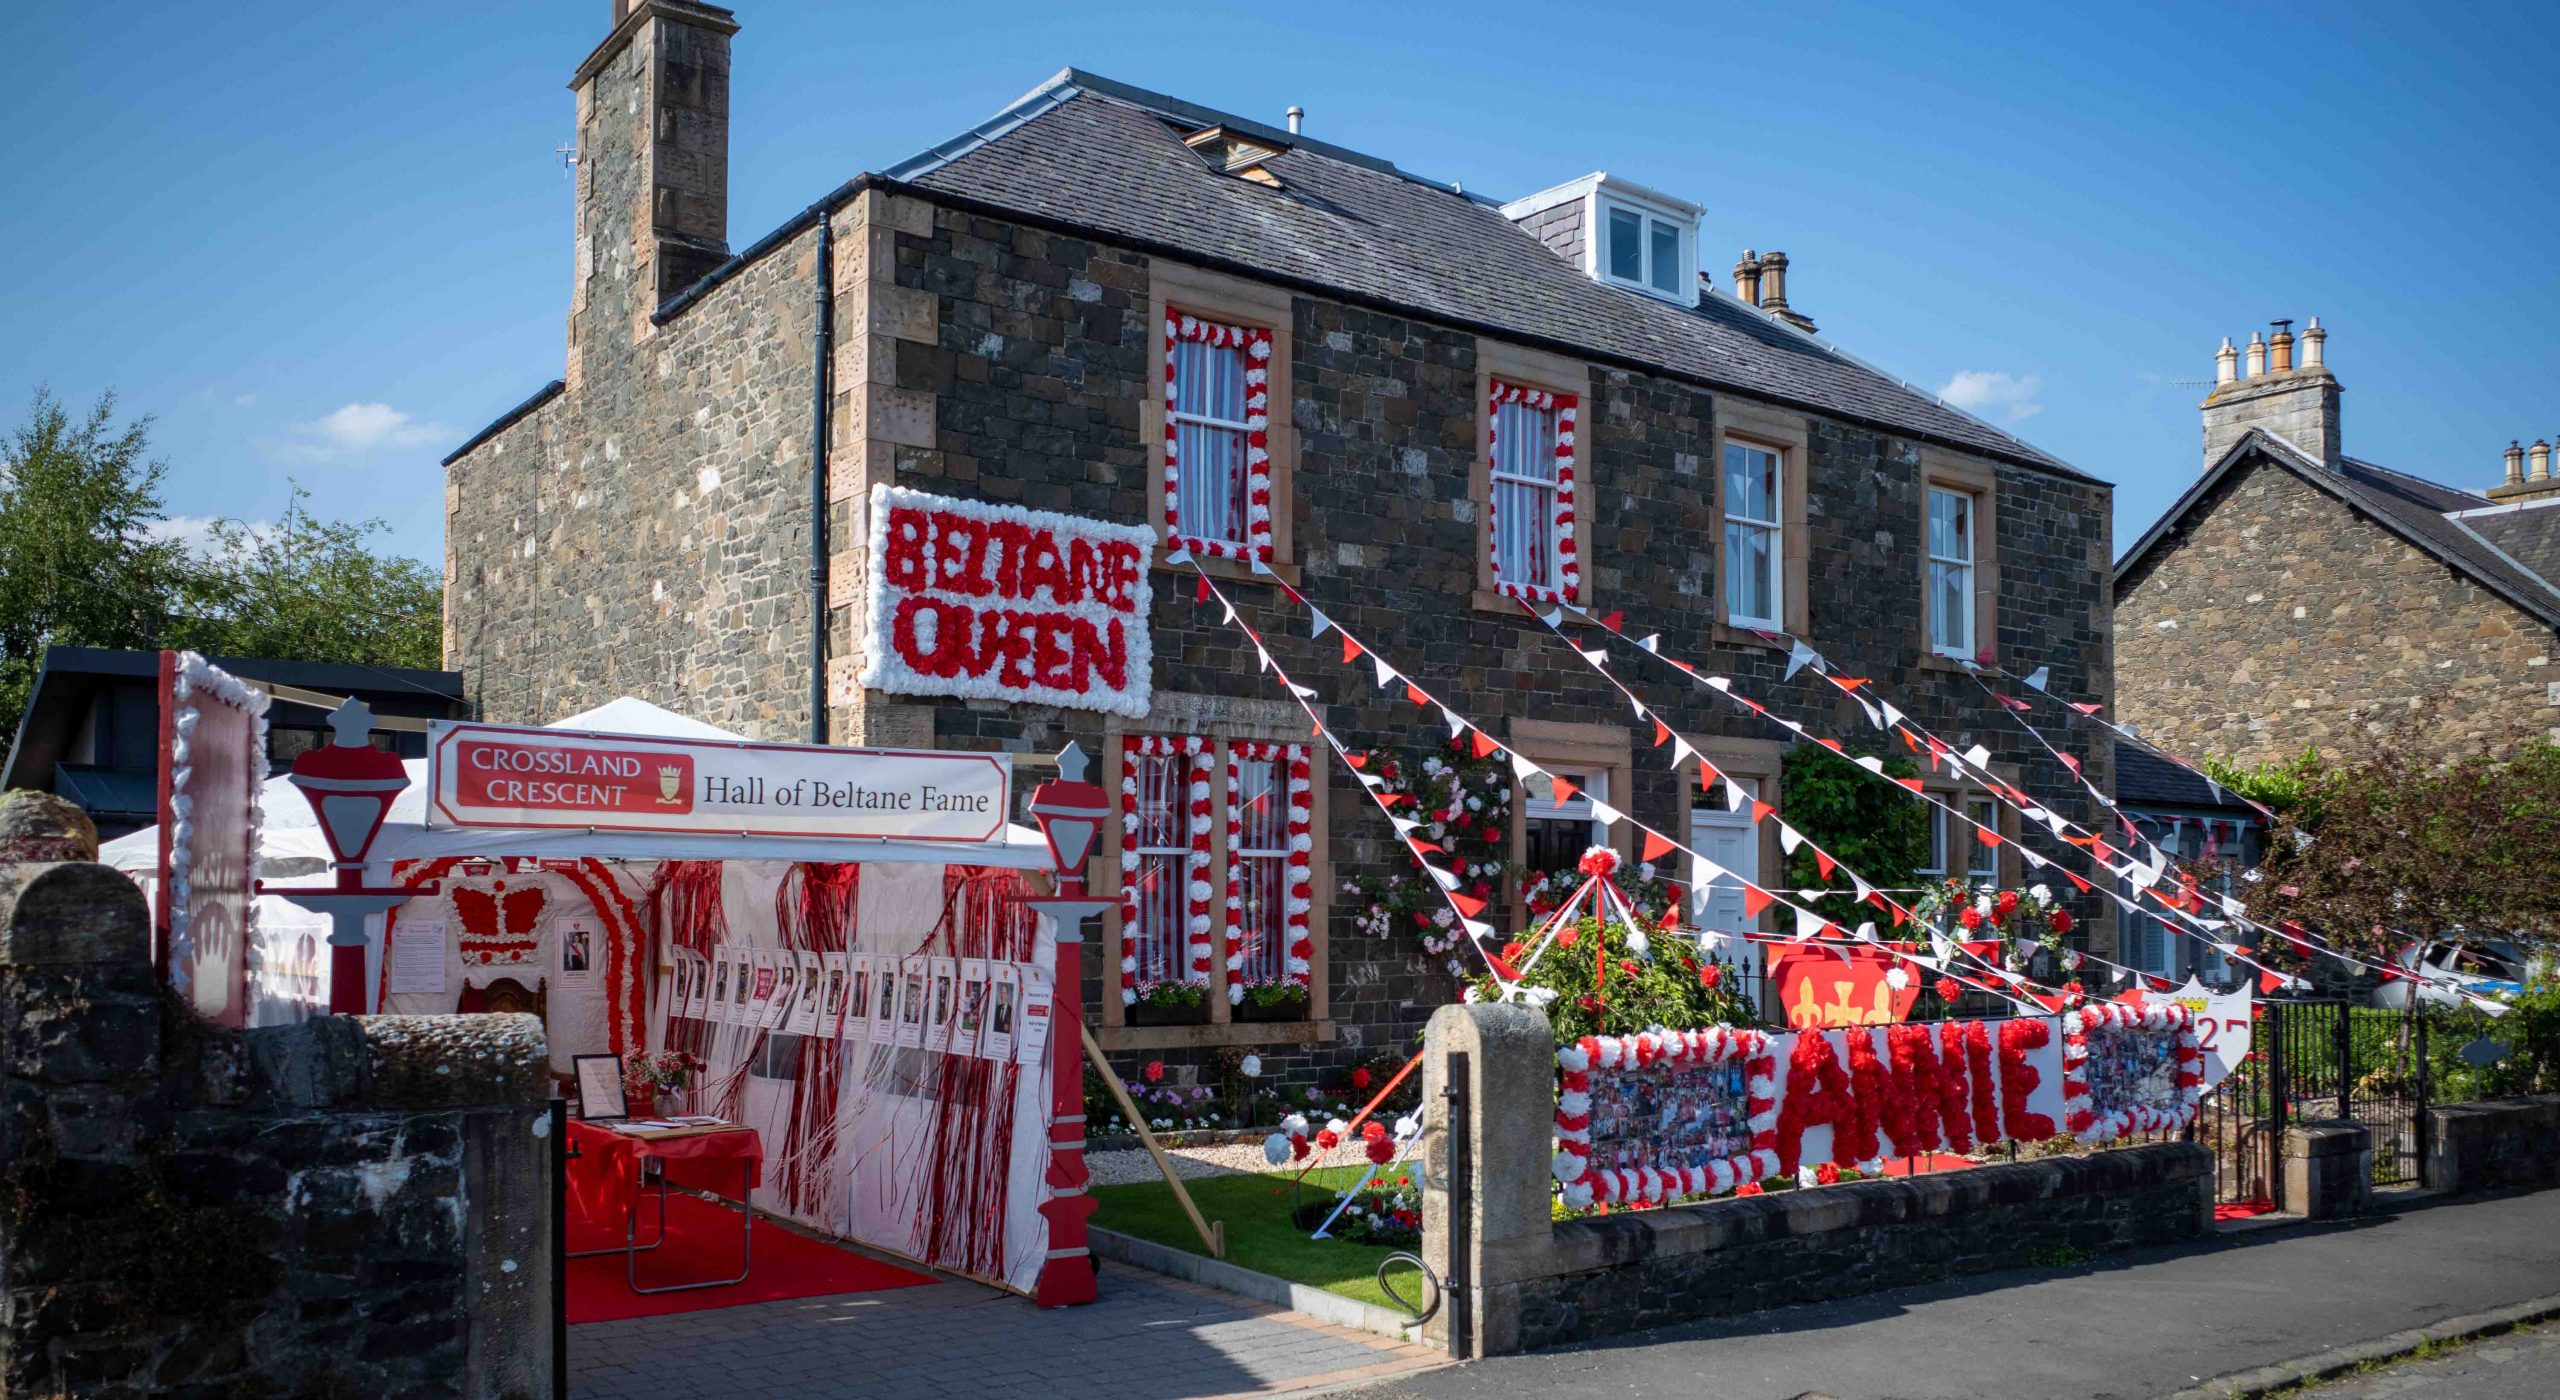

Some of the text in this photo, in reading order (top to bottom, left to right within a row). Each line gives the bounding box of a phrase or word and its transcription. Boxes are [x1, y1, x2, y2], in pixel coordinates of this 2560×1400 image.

[885, 507, 1141, 613] BELTANE
[893, 595, 1128, 694] QUEEN
[471, 747, 642, 778] CROSSLAND
[486, 779, 627, 806] CRESCENT
[703, 776, 989, 812] Hall of Beltane Fame
[1776, 1018, 2056, 1178] ANNIE
